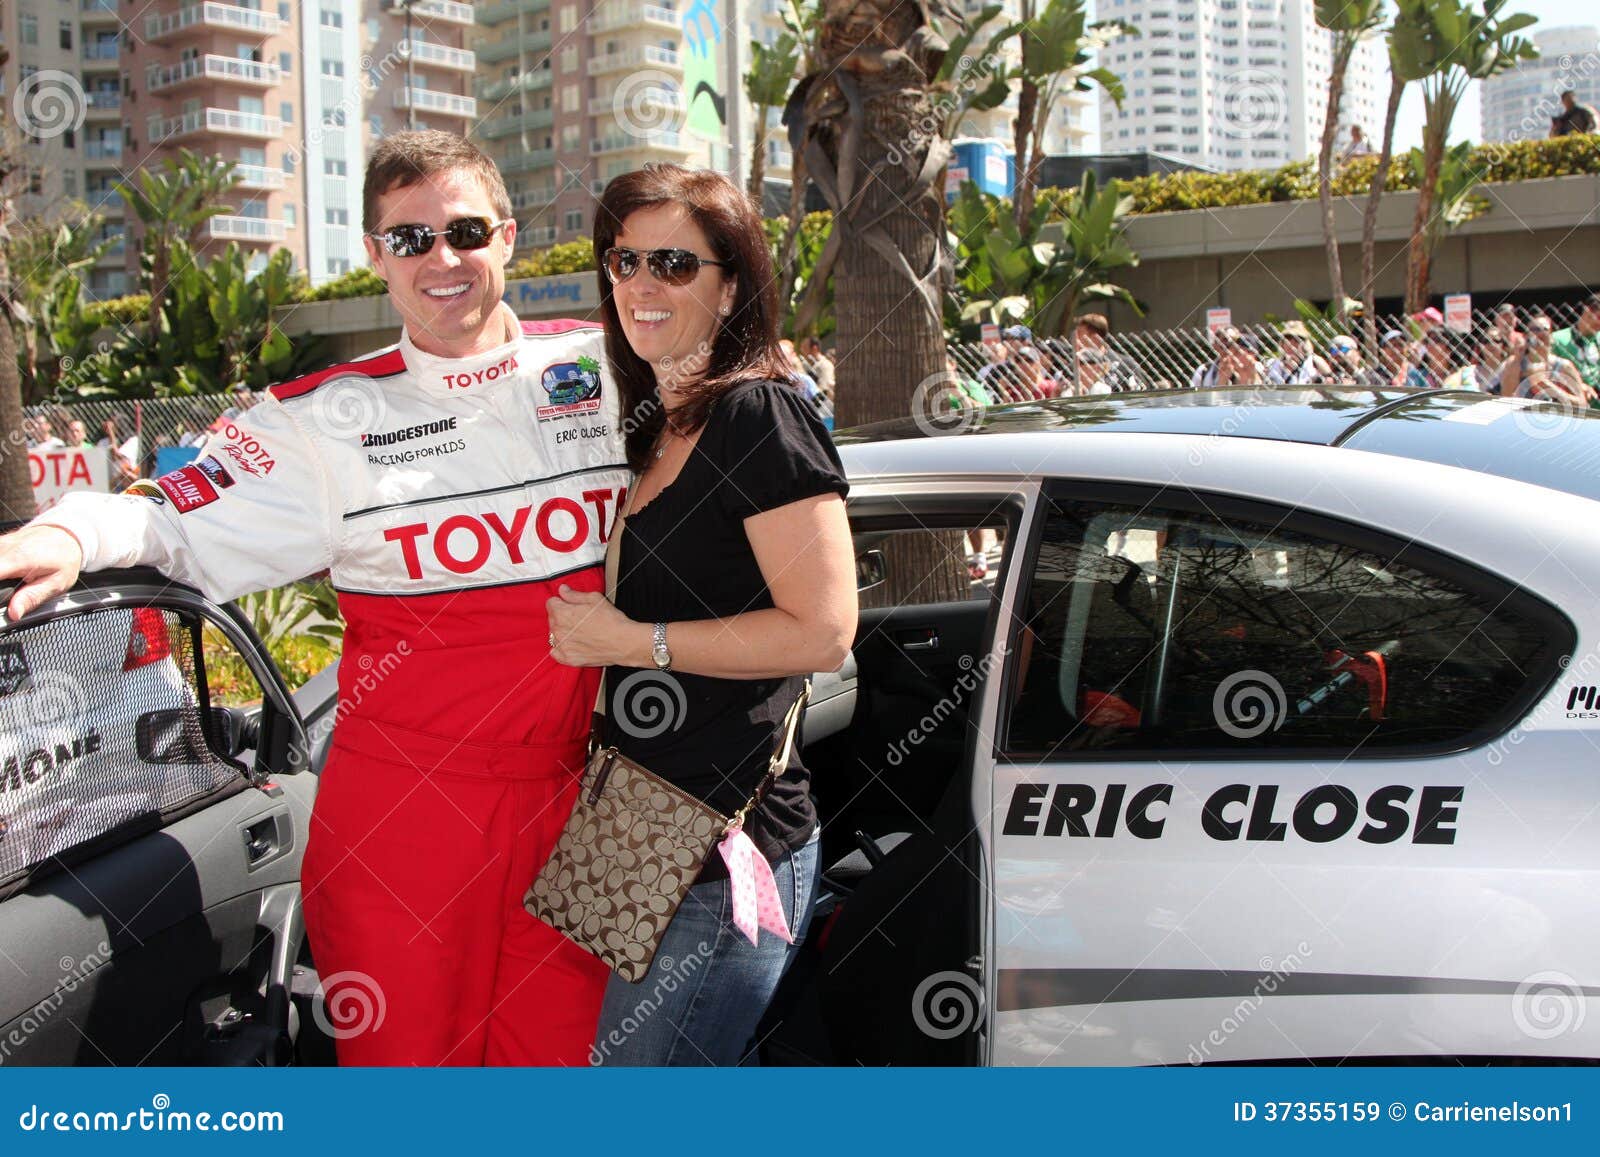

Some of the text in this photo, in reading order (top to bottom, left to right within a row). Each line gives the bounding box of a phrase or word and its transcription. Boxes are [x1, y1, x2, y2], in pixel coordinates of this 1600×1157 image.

[520, 282, 582, 302] Parking
[443, 356, 519, 389] TOYOTA
[360, 416, 457, 447] BRIDGESTONE
[556, 425, 608, 444] ERIC CLOSE
[178, 479, 205, 505] LINE
[1002, 783, 1465, 845] ERIC CLOSE
